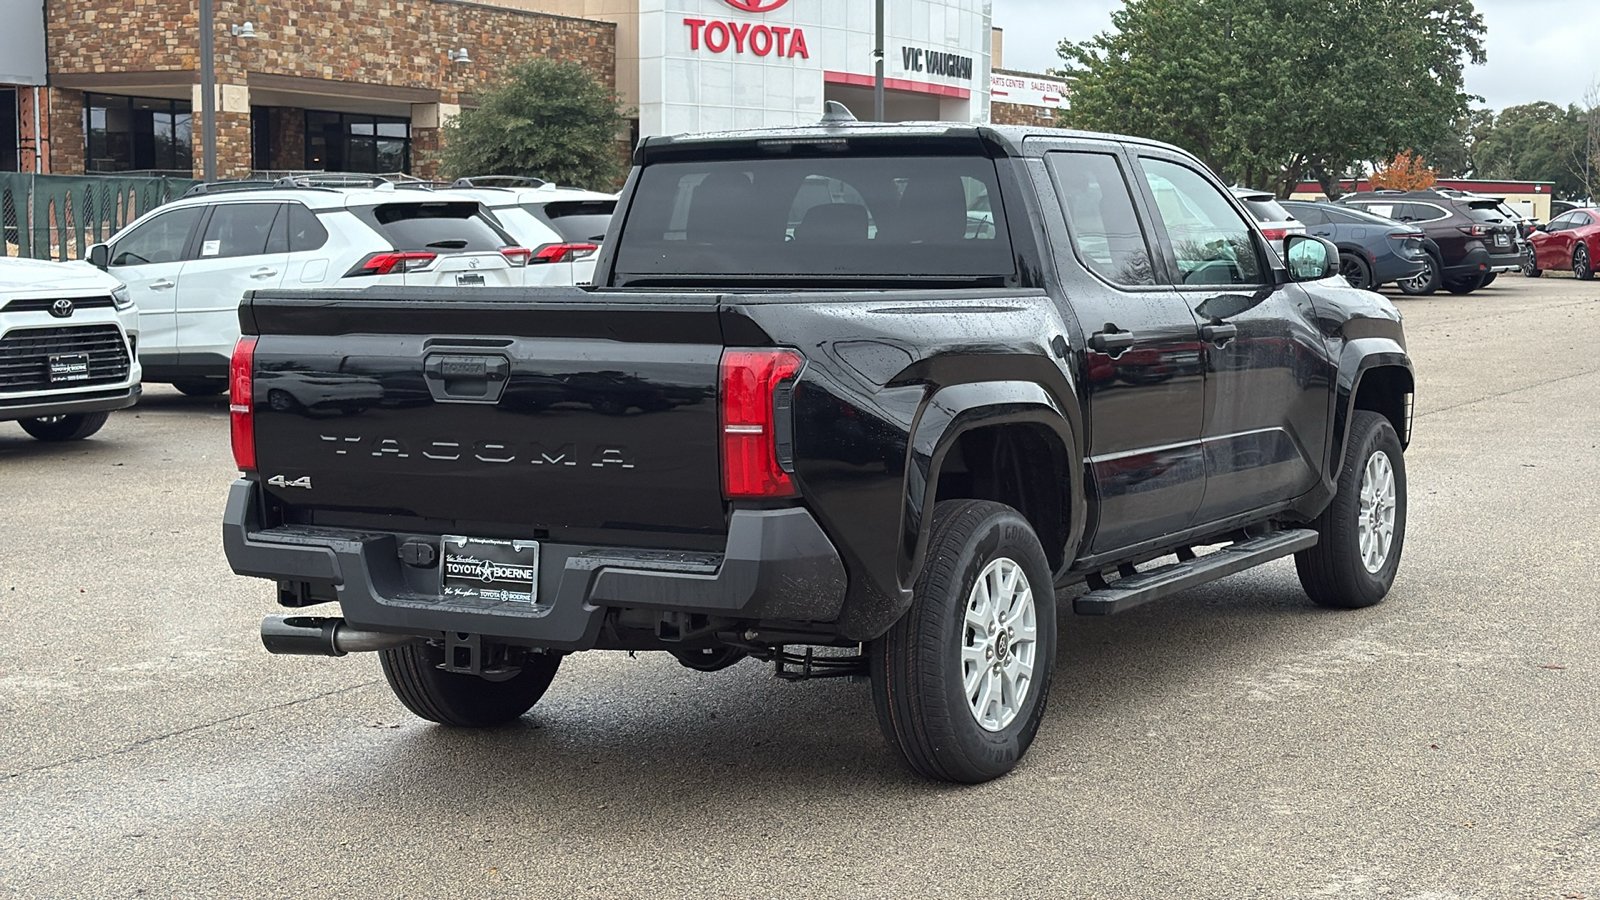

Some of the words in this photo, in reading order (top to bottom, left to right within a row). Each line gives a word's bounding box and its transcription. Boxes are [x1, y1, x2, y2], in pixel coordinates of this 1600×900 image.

[683, 18, 809, 60] TOYOTA
[902, 46, 923, 73] VIC
[925, 50, 973, 80] VAUGHAN
[1006, 78, 1025, 89] CENTER
[1031, 81, 1045, 92] SALES
[1046, 83, 1068, 95] ENTRAN
[444, 362, 482, 373] TOYOTA
[320, 434, 635, 469] TACOMA
[446, 563, 482, 575] TOYOTA
[494, 568, 533, 579] BOERNE
